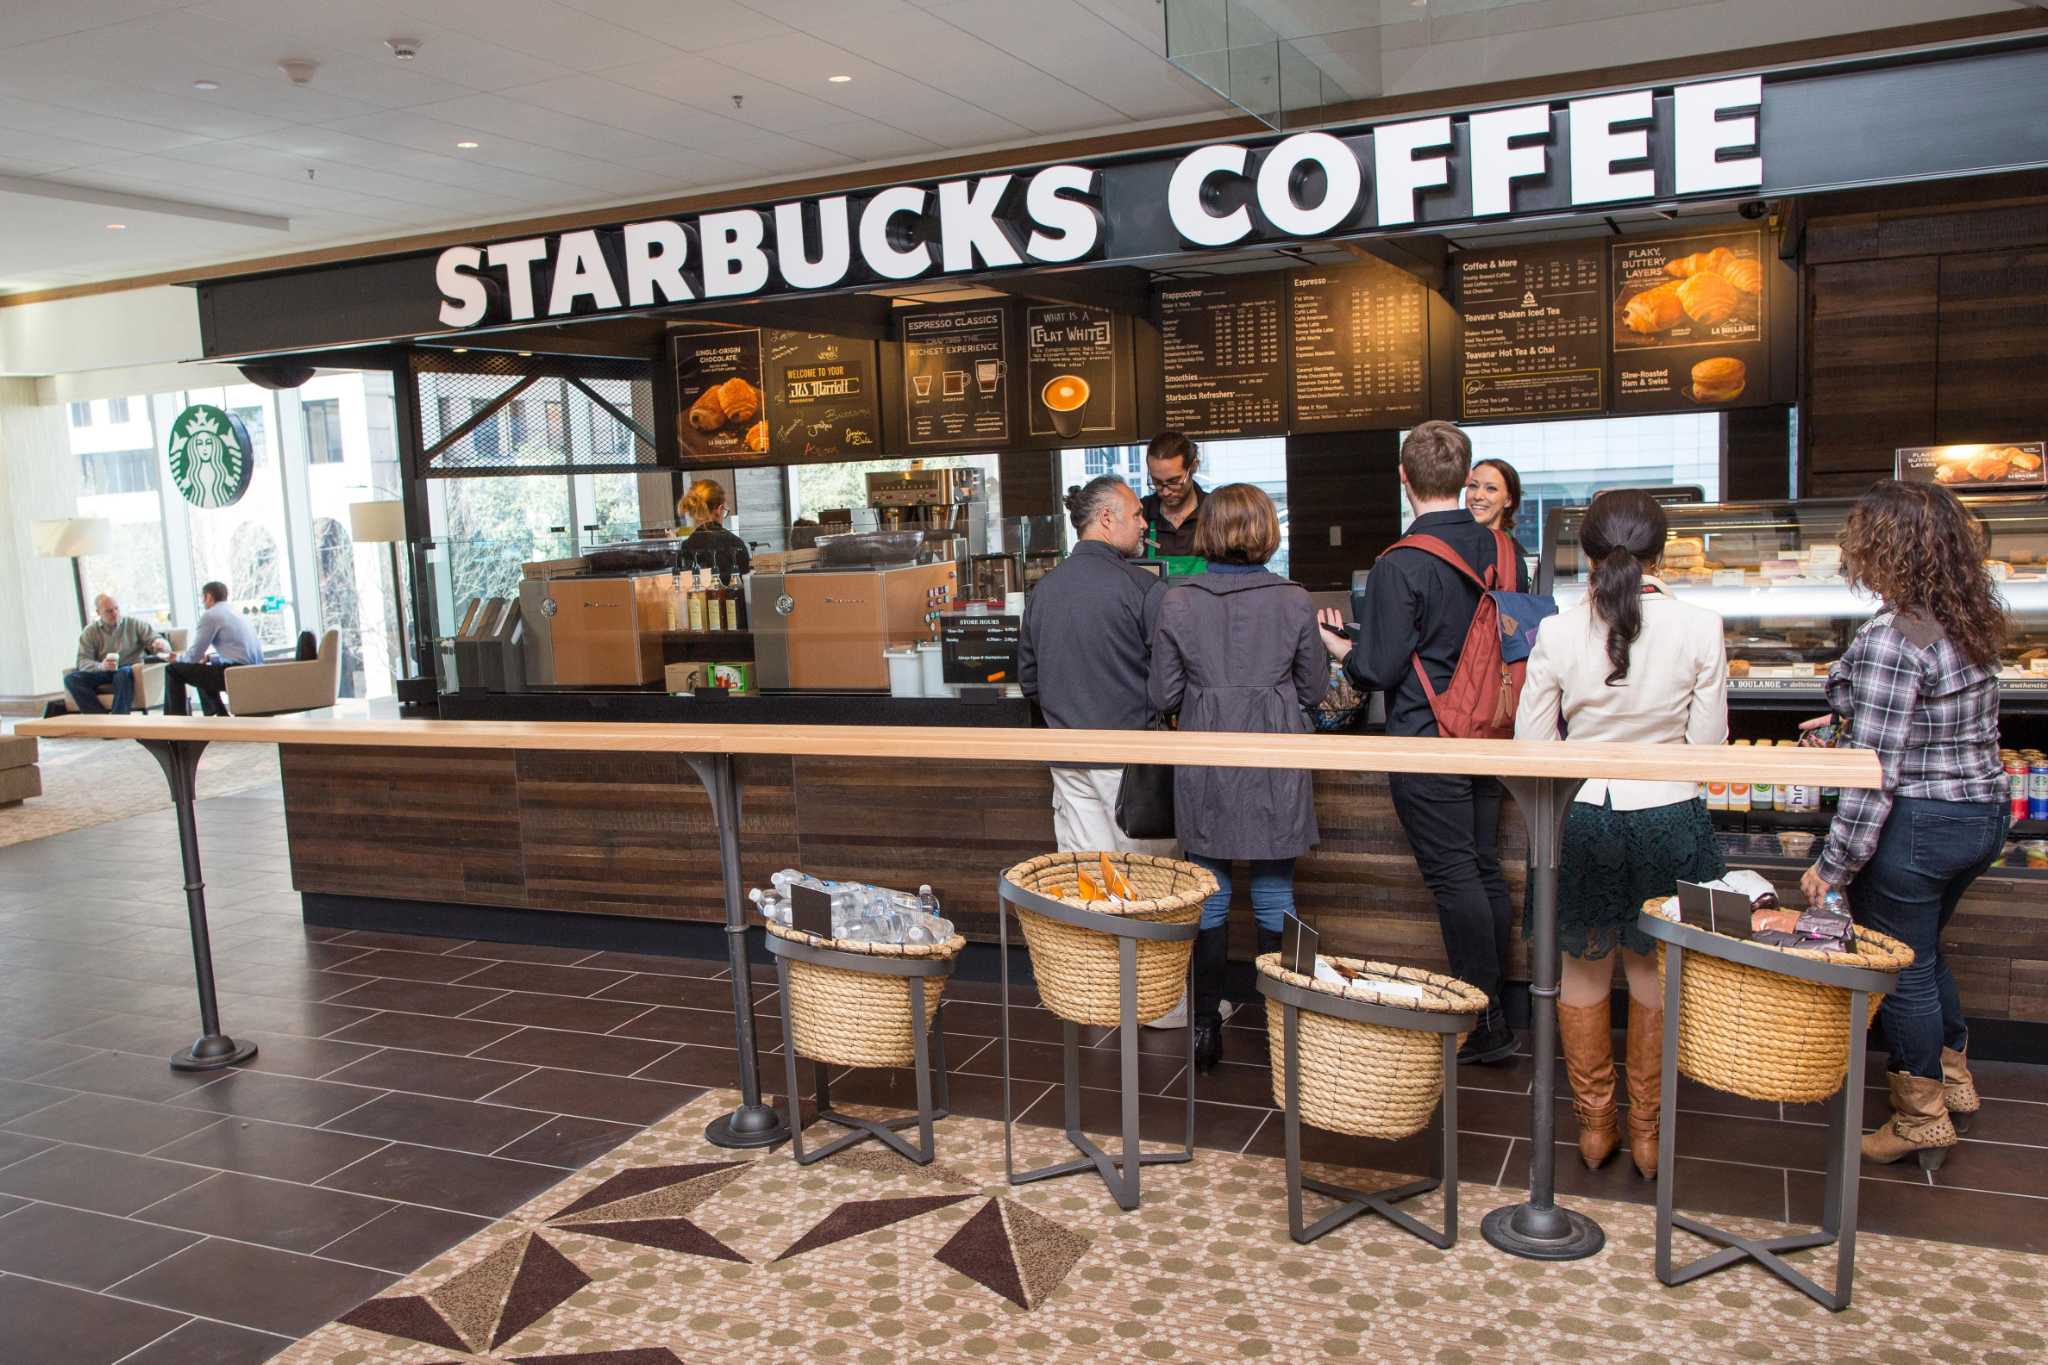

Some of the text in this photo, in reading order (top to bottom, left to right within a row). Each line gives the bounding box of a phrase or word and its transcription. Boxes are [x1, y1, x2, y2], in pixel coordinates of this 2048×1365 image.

[435, 75, 1763, 328] STARBUCKS COFFEE
[1629, 247, 1661, 258] FLAKY,
[1463, 259, 1517, 271] Coffee & More
[1622, 257, 1666, 269] BUTTERY
[1626, 268, 1662, 279] LAYERS
[1294, 278, 1327, 288] Espresso
[1043, 311, 1089, 323] WHAT IS A
[1498, 309, 1526, 319] Shaken
[1527, 308, 1545, 317] Iced
[1546, 306, 1561, 316] Tea
[908, 319, 952, 331] ESPRESSO
[954, 315, 998, 327] CLASSICS
[1066, 326, 1105, 342] WHITE
[946, 343, 999, 354] EXPERIENCE
[1499, 349, 1513, 358] Hot
[1514, 346, 1528, 356] Tea
[1529, 346, 1536, 355] &
[1537, 344, 1555, 354] Chai
[699, 354, 737, 364] CHOCOLATE
[787, 366, 844, 379] WELCOME TO YOUR
[1165, 374, 1198, 383] Smoothies
[810, 379, 848, 397] Marriott
[1621, 379, 1638, 388] Ham
[1648, 376, 1669, 386] Swiss
[1165, 393, 1198, 402] Starbucks
[1738, 679, 1781, 688] BOULANGE
